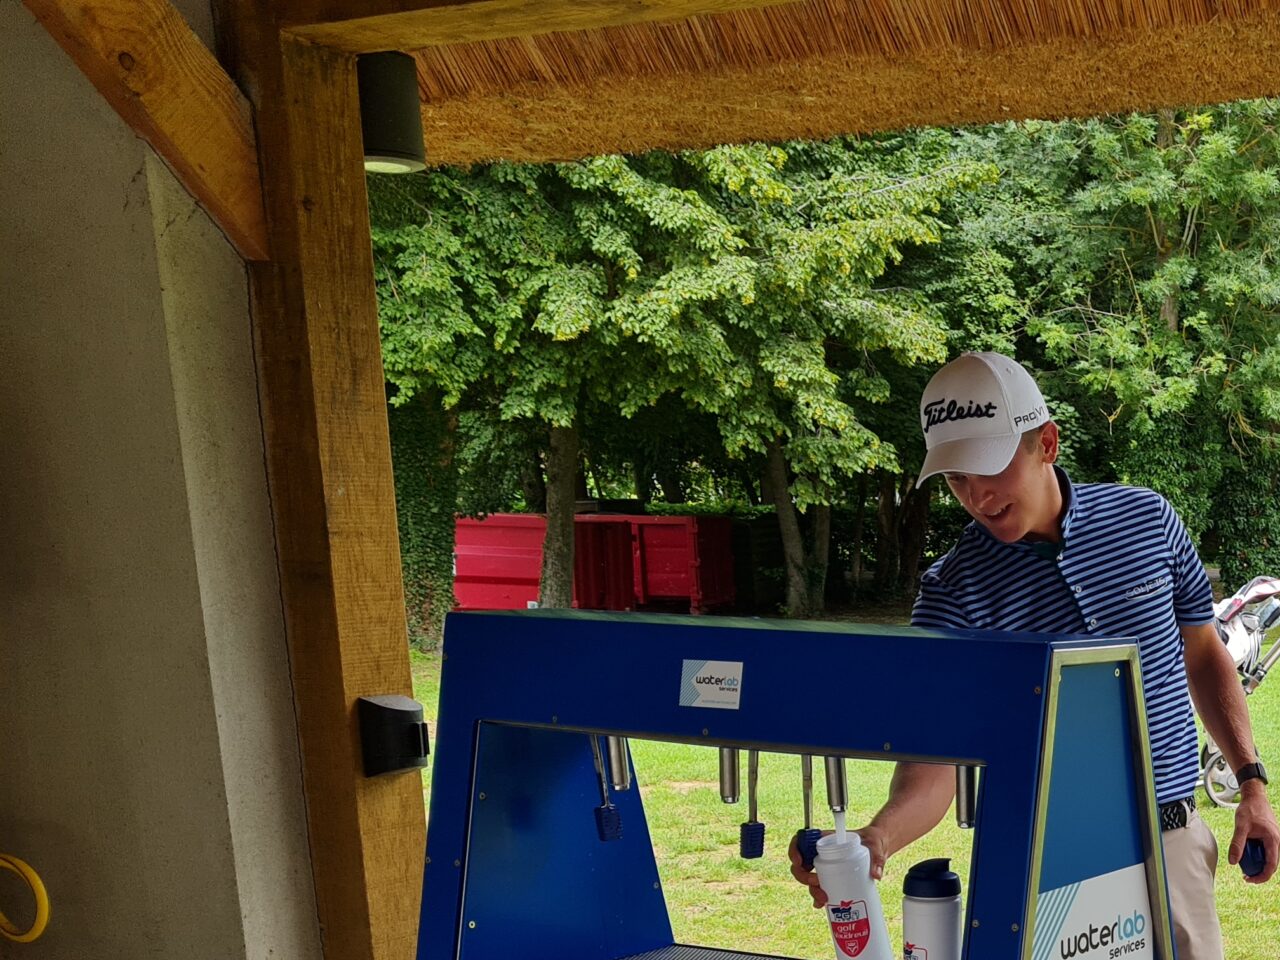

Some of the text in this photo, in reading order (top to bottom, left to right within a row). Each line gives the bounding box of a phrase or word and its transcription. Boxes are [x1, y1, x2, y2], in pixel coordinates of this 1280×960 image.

[923, 398, 998, 434] Titleist
[695, 675, 739, 686] waterlab
[1060, 909, 1146, 960] waterlab
[1108, 937, 1147, 960] services
